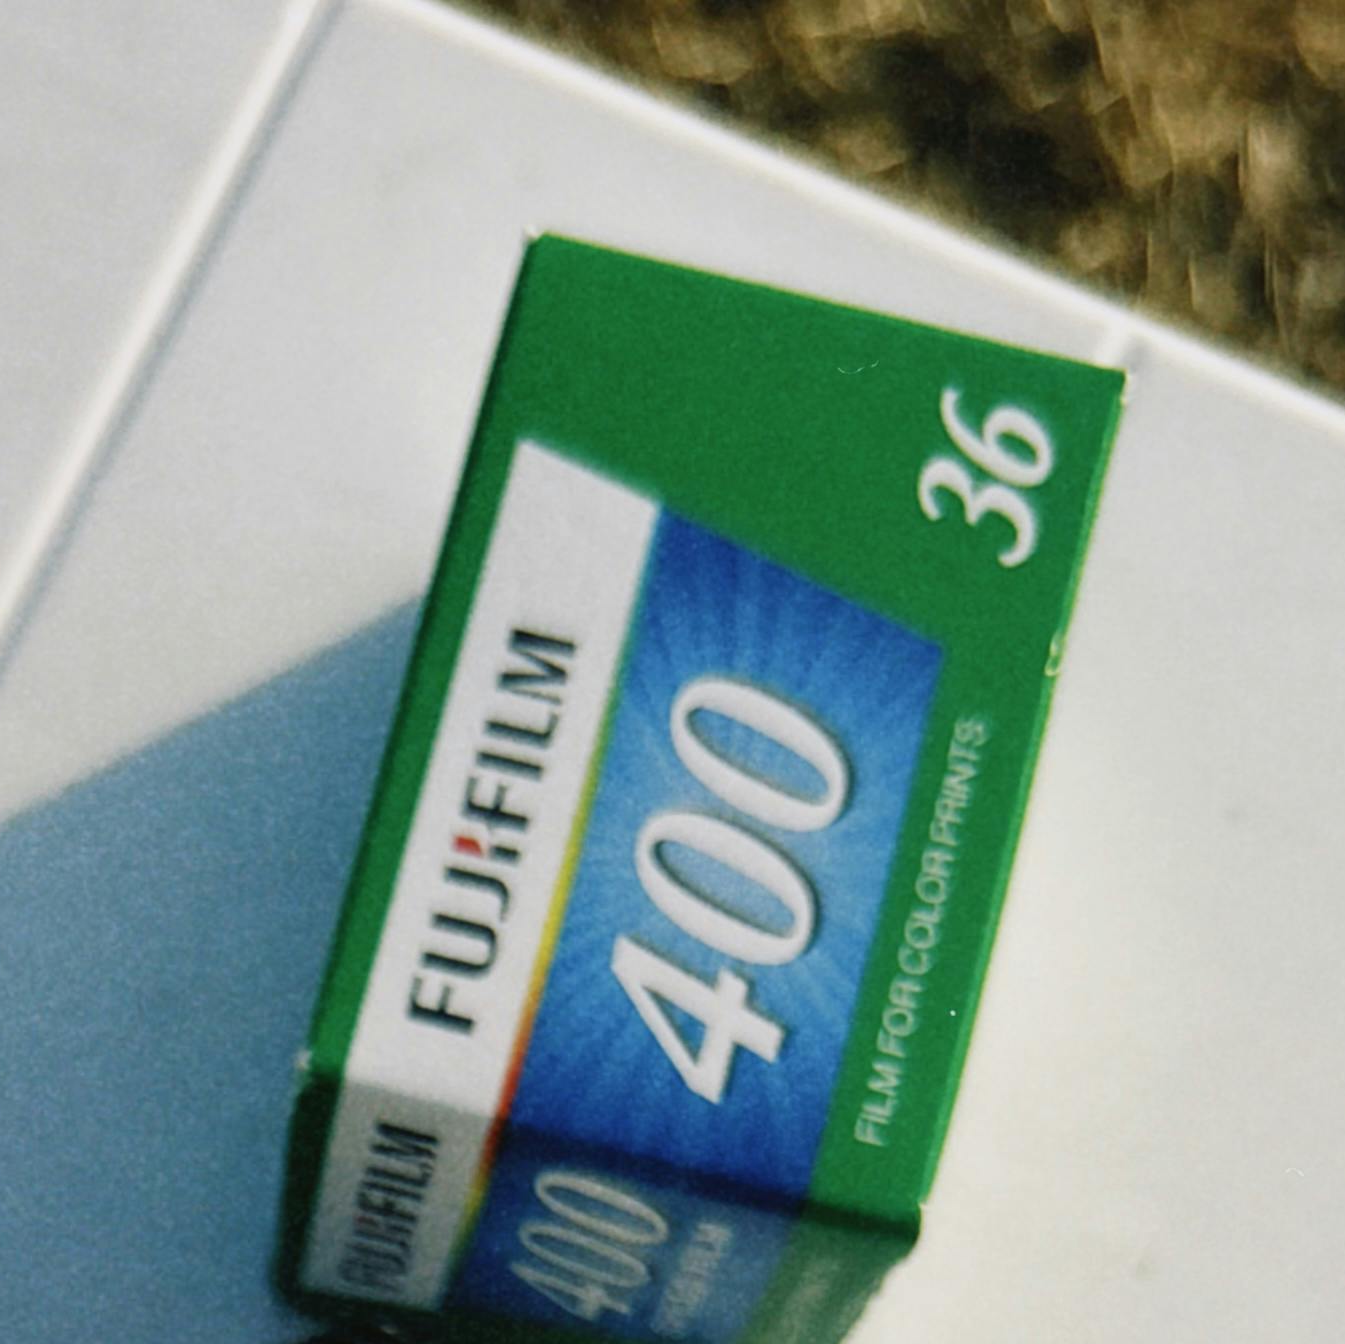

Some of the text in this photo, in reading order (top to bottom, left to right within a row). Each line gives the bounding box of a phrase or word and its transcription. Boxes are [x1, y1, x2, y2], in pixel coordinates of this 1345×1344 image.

[916, 384, 1056, 568] 36
[407, 627, 578, 1038] FUJIFILM
[610, 676, 852, 1104] 400
[854, 714, 995, 1147] FILM FOR COLOR PRINTS
[338, 1121, 439, 1293] FUJIFILM
[510, 1167, 670, 1321] 400
